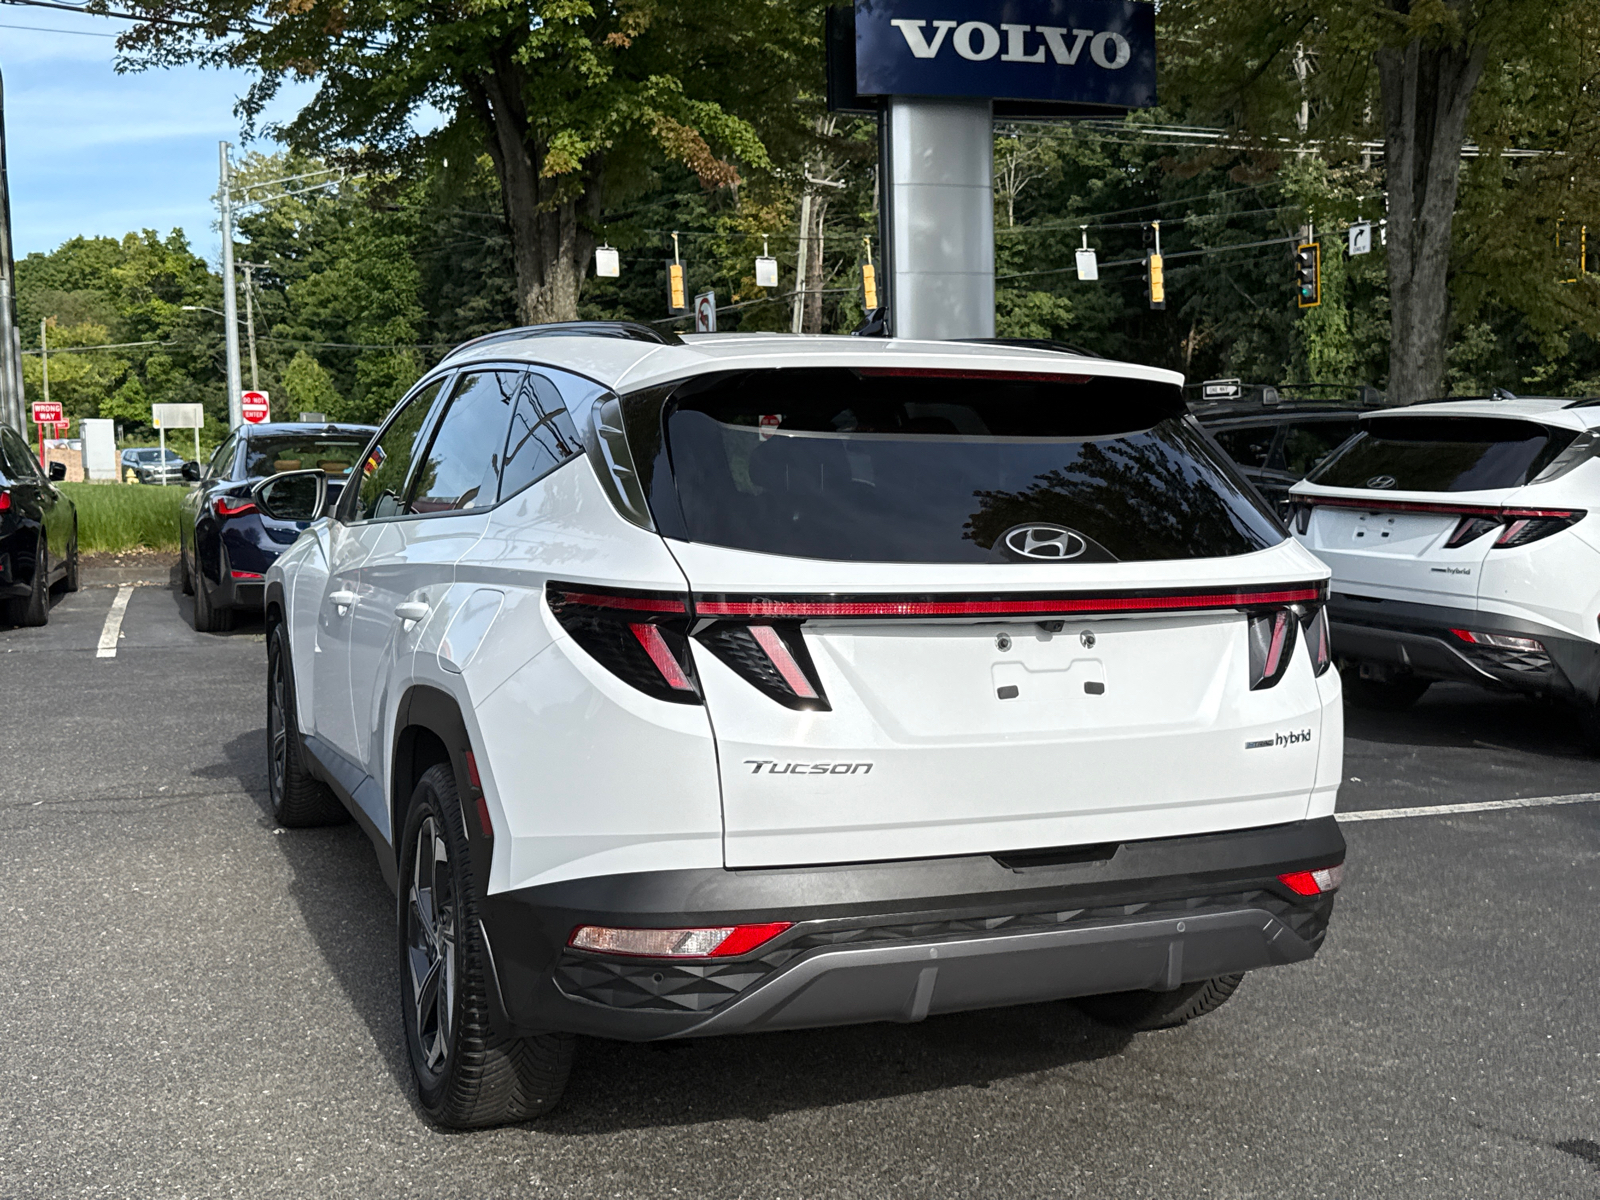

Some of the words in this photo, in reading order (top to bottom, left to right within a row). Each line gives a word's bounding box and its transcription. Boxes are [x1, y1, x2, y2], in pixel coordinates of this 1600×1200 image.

[890, 19, 1131, 70] VOLVO
[1447, 567, 1471, 575] hybrid
[1275, 729, 1311, 748] hybrid
